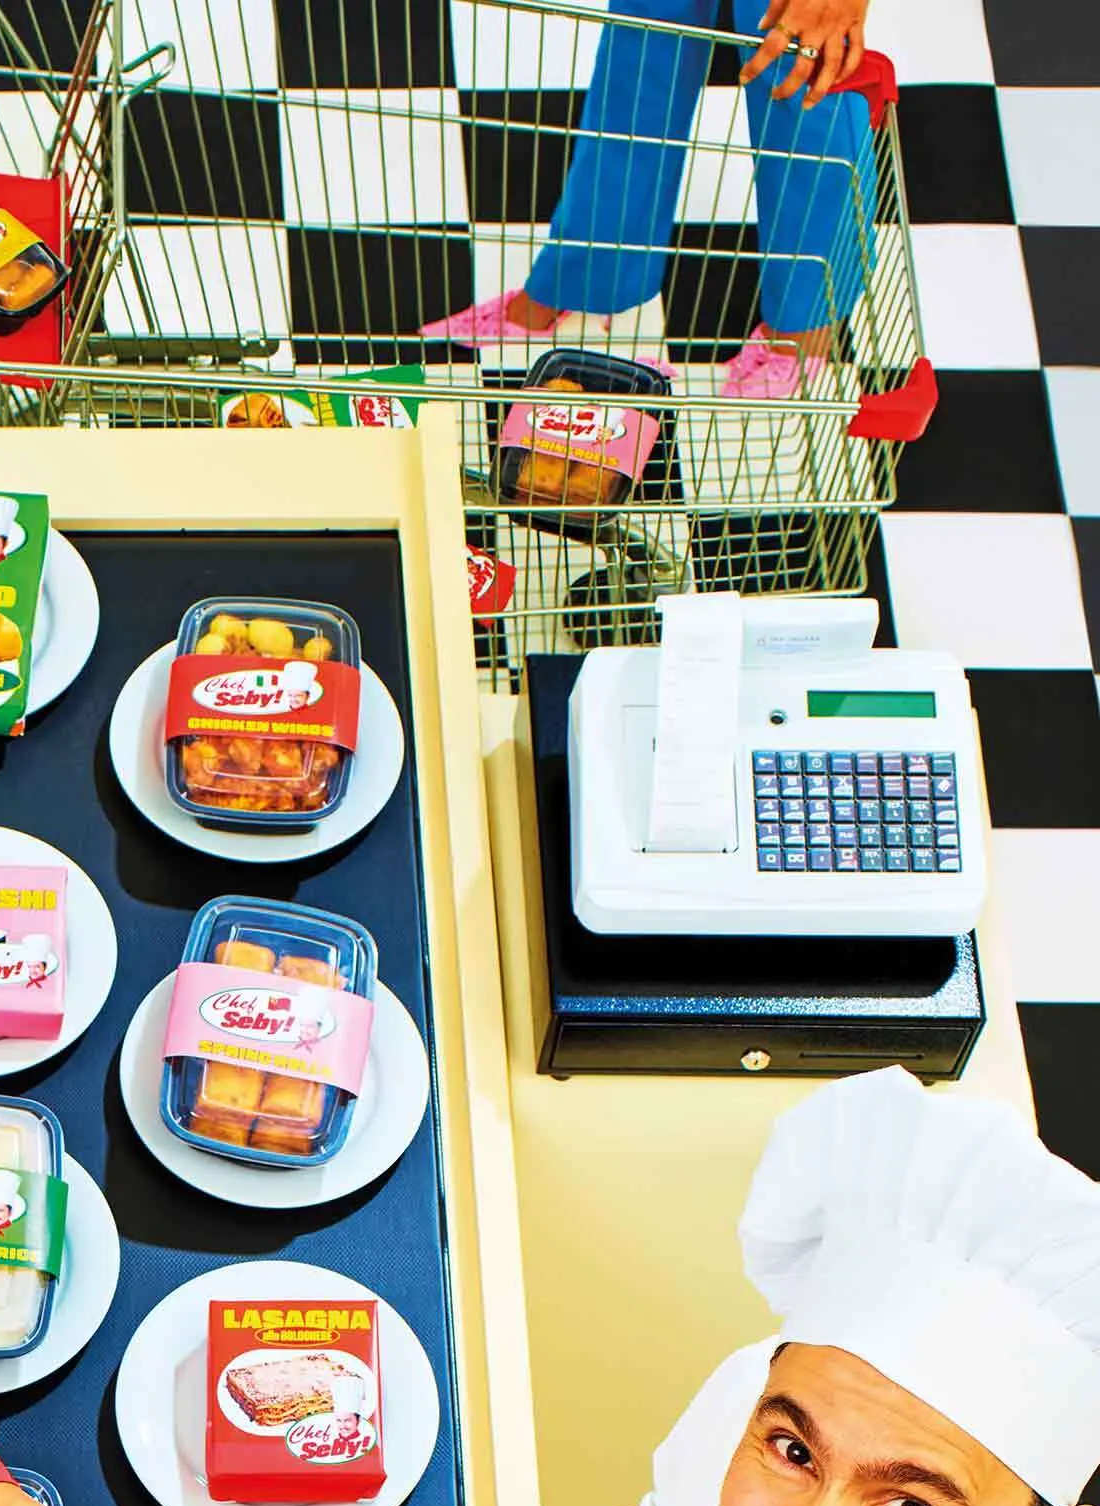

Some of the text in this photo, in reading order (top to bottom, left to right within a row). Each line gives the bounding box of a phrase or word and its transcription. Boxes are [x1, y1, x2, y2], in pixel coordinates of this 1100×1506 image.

[205, 678, 246, 692] Chef
[214, 690, 284, 708] Seby!
[212, 993, 258, 1014] Chef
[220, 1011, 296, 1035] Seby!
[223, 1309, 372, 1330] LASAGNA
[289, 1424, 331, 1443] Chef
[299, 1437, 371, 1461] Seby!
